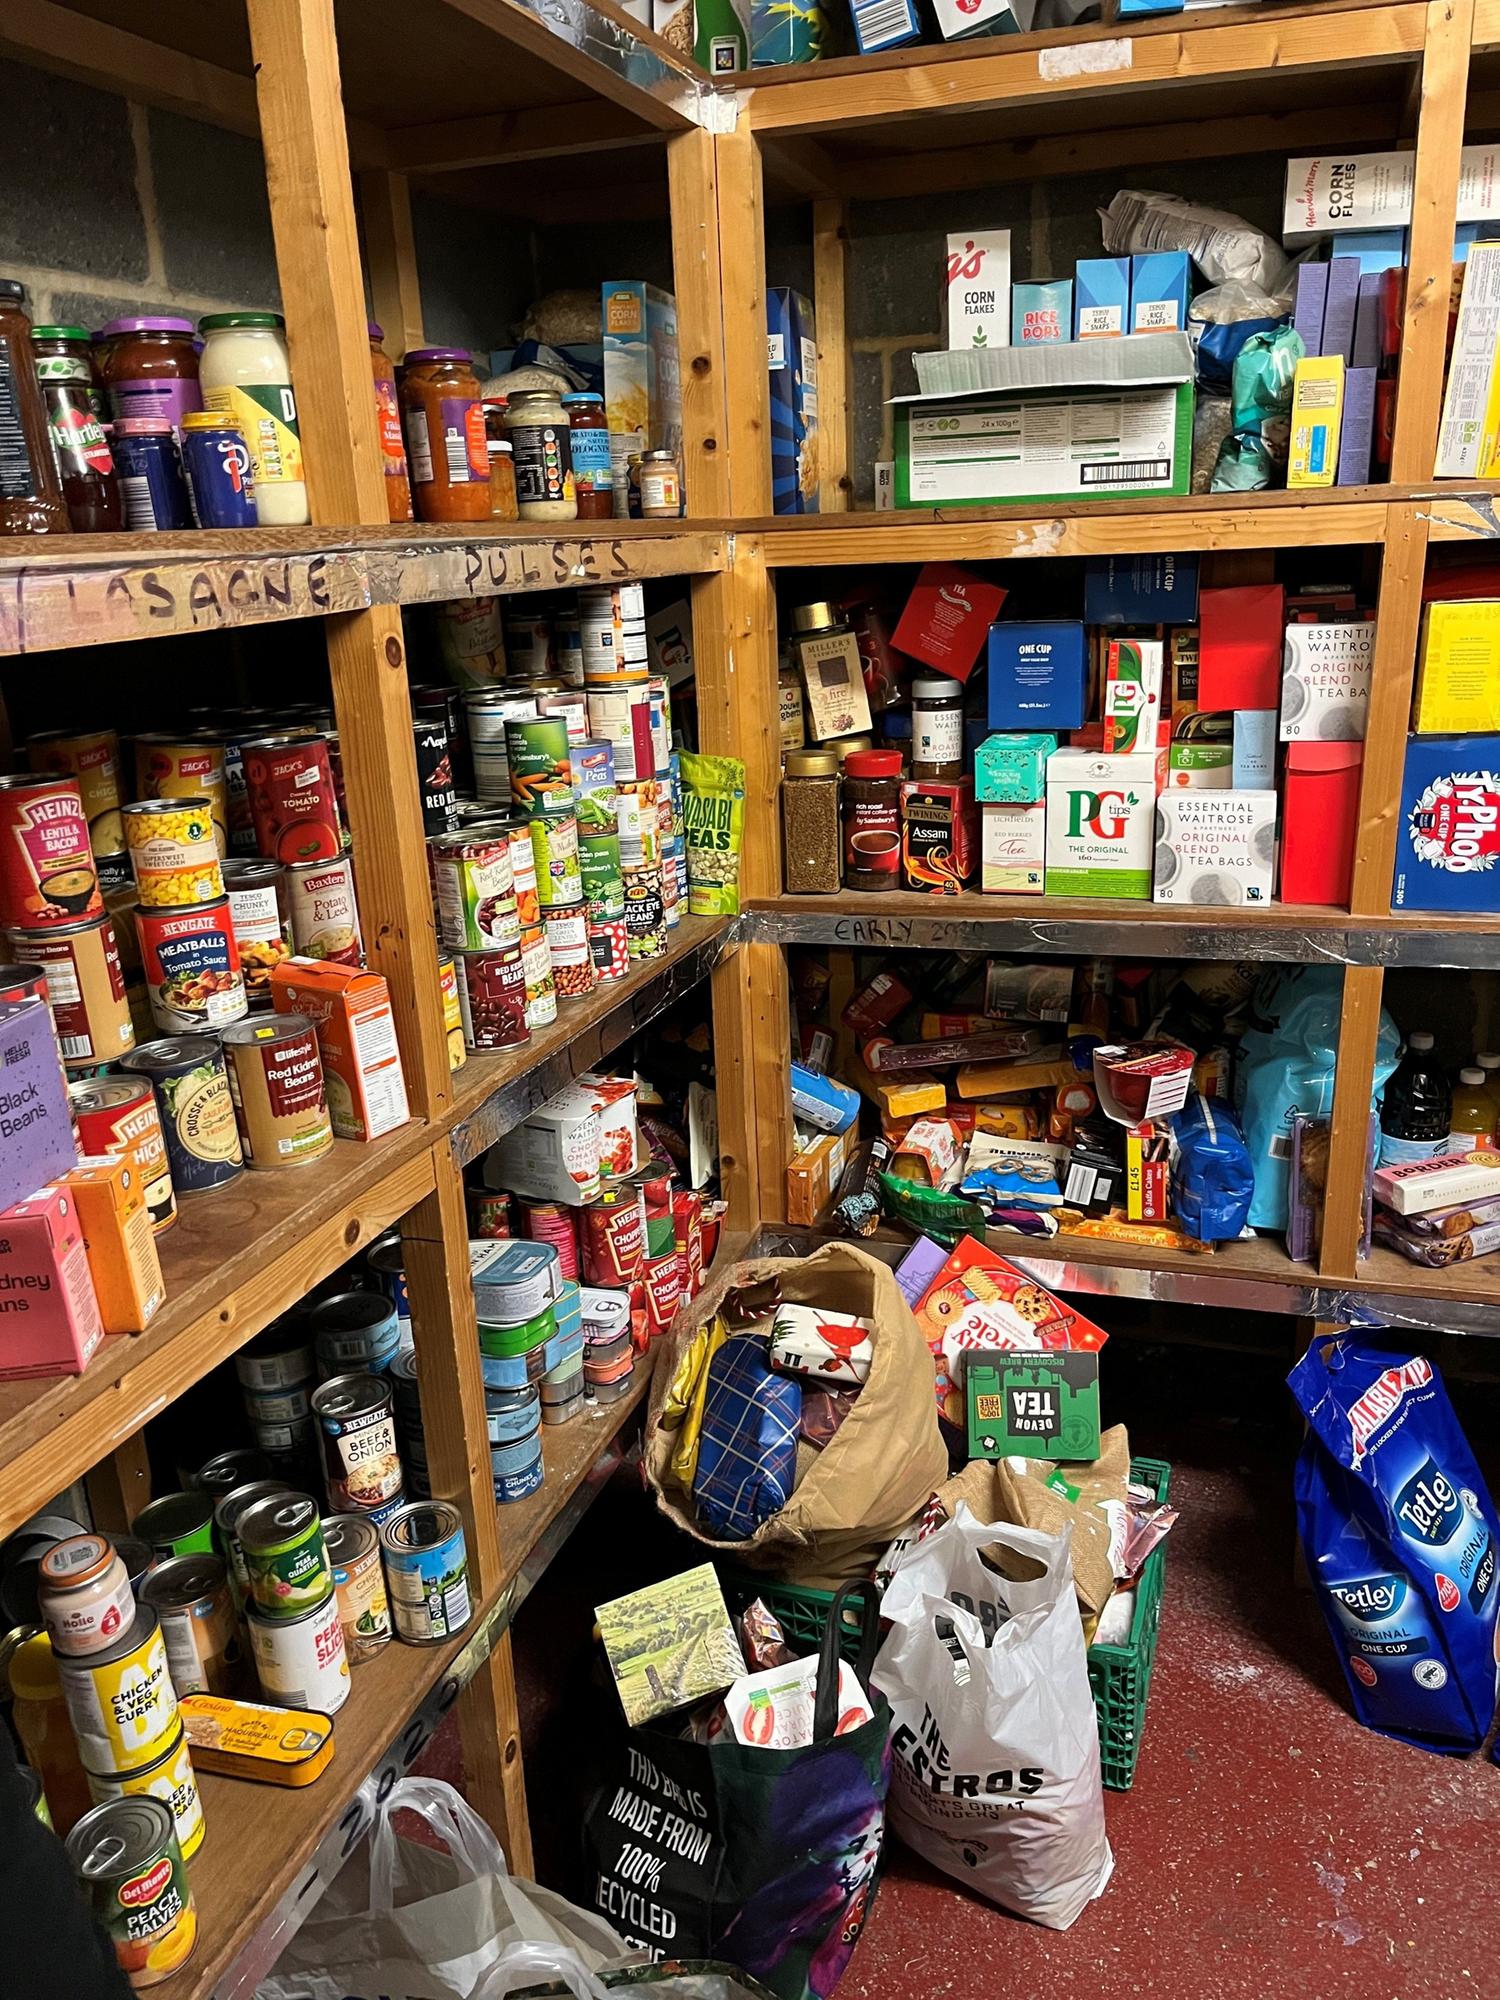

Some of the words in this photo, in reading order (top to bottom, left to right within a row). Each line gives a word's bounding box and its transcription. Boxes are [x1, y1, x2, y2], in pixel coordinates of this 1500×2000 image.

[1328, 163, 1345, 219] CORN
[1341, 162, 1356, 218] FLAKES
[964, 291, 996, 305] CORN
[610, 310, 638, 320] CORN
[964, 304, 996, 316] FLAKES
[1024, 311, 1057, 325] RICE
[1149, 311, 1164, 319] RICE
[1090, 323, 1110, 331] SNAPS
[1093, 317, 1108, 325] RICE
[1146, 318, 1166, 326] SNAPS
[1022, 326, 1060, 341] POPS
[464, 541, 632, 595] PULSES
[1164, 556, 1175, 575] ONE
[1164, 575, 1174, 592] CUP
[806, 637, 852, 655] MILLER'S
[1017, 645, 1035, 656] ONE
[1035, 644, 1053, 654] CUP
[1307, 641, 1371, 653] WAITRO
[1303, 675, 1352, 686] BLEND
[829, 688, 847, 701] fire
[1318, 688, 1345, 698] TEA
[1349, 688, 1369, 698] BA
[1285, 725, 1300, 736] 80
[180, 758, 211, 774] JACK'S
[273, 759, 304, 777] JACK'S
[584, 770, 608, 782] Peas
[281, 794, 321, 809] TOMATO
[425, 793, 445, 809] RED
[1177, 802, 1255, 813] ESSENTIAL
[30, 800, 79, 824] HEINZ
[863, 816, 895, 825] Sainsbury's
[907, 807, 950, 821] TWININGS
[1063, 789, 1131, 840] PG
[1108, 803, 1132, 818] tips
[1178, 813, 1254, 825] WAITROSE
[1438, 803, 1451, 823] ONE
[40, 826, 72, 841] LENTIL
[912, 826, 948, 840] Assam
[1180, 832, 1249, 844] ORIGINAL
[1437, 823, 1450, 840] CUP
[45, 836, 79, 852] BACON
[998, 838, 1027, 856] Tea
[1068, 845, 1086, 854] THE
[1086, 845, 1129, 855] ORIGINAL
[1174, 844, 1220, 855] BLEND
[1189, 856, 1213, 866] TEA
[1218, 856, 1253, 867] BAGS
[305, 873, 346, 892] Baxters
[943, 880, 955, 890] 40
[1159, 889, 1174, 899] 80
[1396, 888, 1404, 905] 300
[233, 899, 270, 911] CHUNKY
[313, 895, 348, 912] Potato
[645, 900, 662, 912] EYE
[312, 910, 325, 922] &
[624, 911, 656, 923] BEANS
[161, 916, 217, 937] NEWGATE
[833, 917, 915, 944] EARLY
[158, 936, 227, 958] MEATBALLS
[165, 959, 201, 975] Tomato
[202, 955, 227, 967] Sauce
[494, 964, 510, 977] RED
[3, 1040, 30, 1059] HELLO
[5, 1048, 32, 1067] FRESH
[267, 1065, 293, 1082] Red
[292, 1055, 320, 1076] Kidney
[283, 1071, 316, 1089] Beans
[0, 1080, 40, 1116] Black
[1, 1102, 49, 1139] Beans
[186, 1102, 205, 1138] CROSSE
[1391, 1157, 1467, 1178] BORDER
[1129, 1166, 1140, 1193] £1.45
[1145, 1168, 1154, 1190] Cakes
[1145, 1190, 1154, 1211] Jaffa
[1012, 1391, 1056, 1417] TEA
[343, 1410, 389, 1432] NEWGATE
[1015, 1417, 1054, 1432] DEVON
[353, 1422, 387, 1440] MINCED
[347, 1436, 393, 1462] ONION
[349, 1433, 382, 1452] BEEF
[504, 1473, 535, 1489] CHUNKS
[1458, 1527, 1488, 1580] ORIGINAL
[286, 1556, 320, 1580] QUARTERS
[294, 1556, 312, 1570] PEAR
[1475, 1569, 1490, 1595] ONE
[1330, 1581, 1398, 1612] Tetley
[62, 1614, 95, 1629] Holle
[1350, 1627, 1411, 1641] ORIGINAL
[1360, 1642, 1384, 1655] ONE
[1384, 1642, 1409, 1655] CUP
[110, 1665, 164, 1705] CHICKEN
[113, 1702, 126, 1715] &
[127, 1689, 154, 1711] VEG
[115, 1693, 160, 1725] CURRY
[190, 1697, 233, 1714] Casino
[919, 1700, 952, 1772] THE
[627, 1746, 660, 1793] THIS
[687, 1780, 710, 1820] IS
[607, 1786, 660, 1843] MADE
[661, 1812, 713, 1867] FROM
[613, 1842, 668, 1895] 100%
[122, 1885, 142, 1901] Del
[139, 1862, 171, 1893] Monte
[126, 1885, 179, 1929] PEACH
[127, 1894, 183, 1941] HALVES
